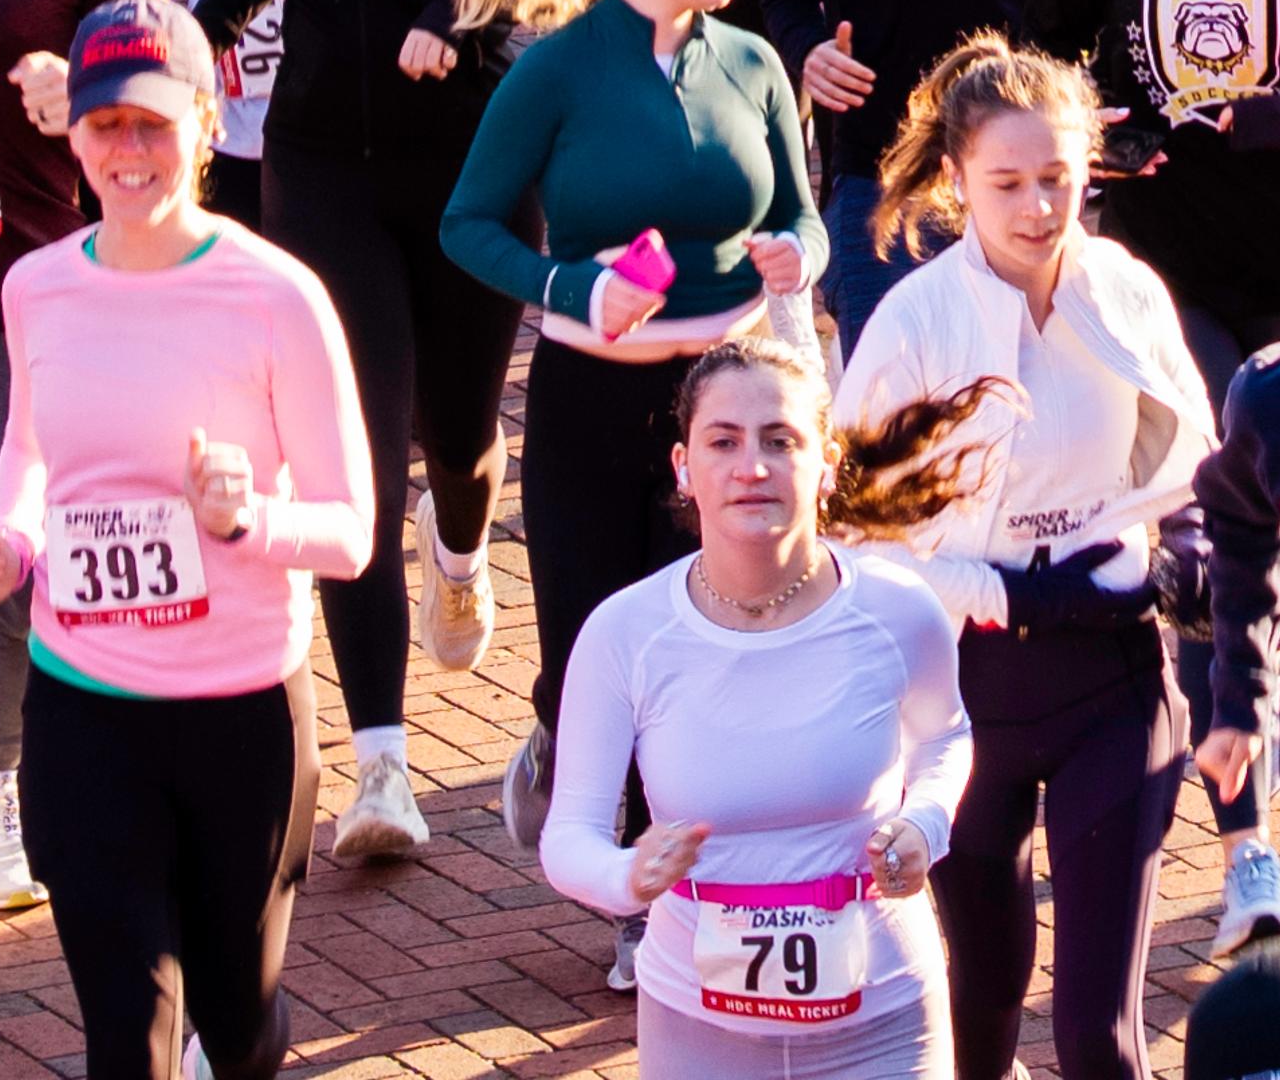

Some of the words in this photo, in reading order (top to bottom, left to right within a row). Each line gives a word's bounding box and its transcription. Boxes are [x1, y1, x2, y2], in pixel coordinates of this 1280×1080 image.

[239, 19, 286, 75] 26
[1007, 509, 1069, 528] SPIDER
[1035, 521, 1082, 539] DASH
[69, 541, 179, 603] 393
[751, 913, 806, 930] DASH
[740, 932, 818, 996] 79
[725, 998, 753, 1013] HDC
[757, 1002, 795, 1018] MEAL
[797, 1002, 848, 1020] TICKET
